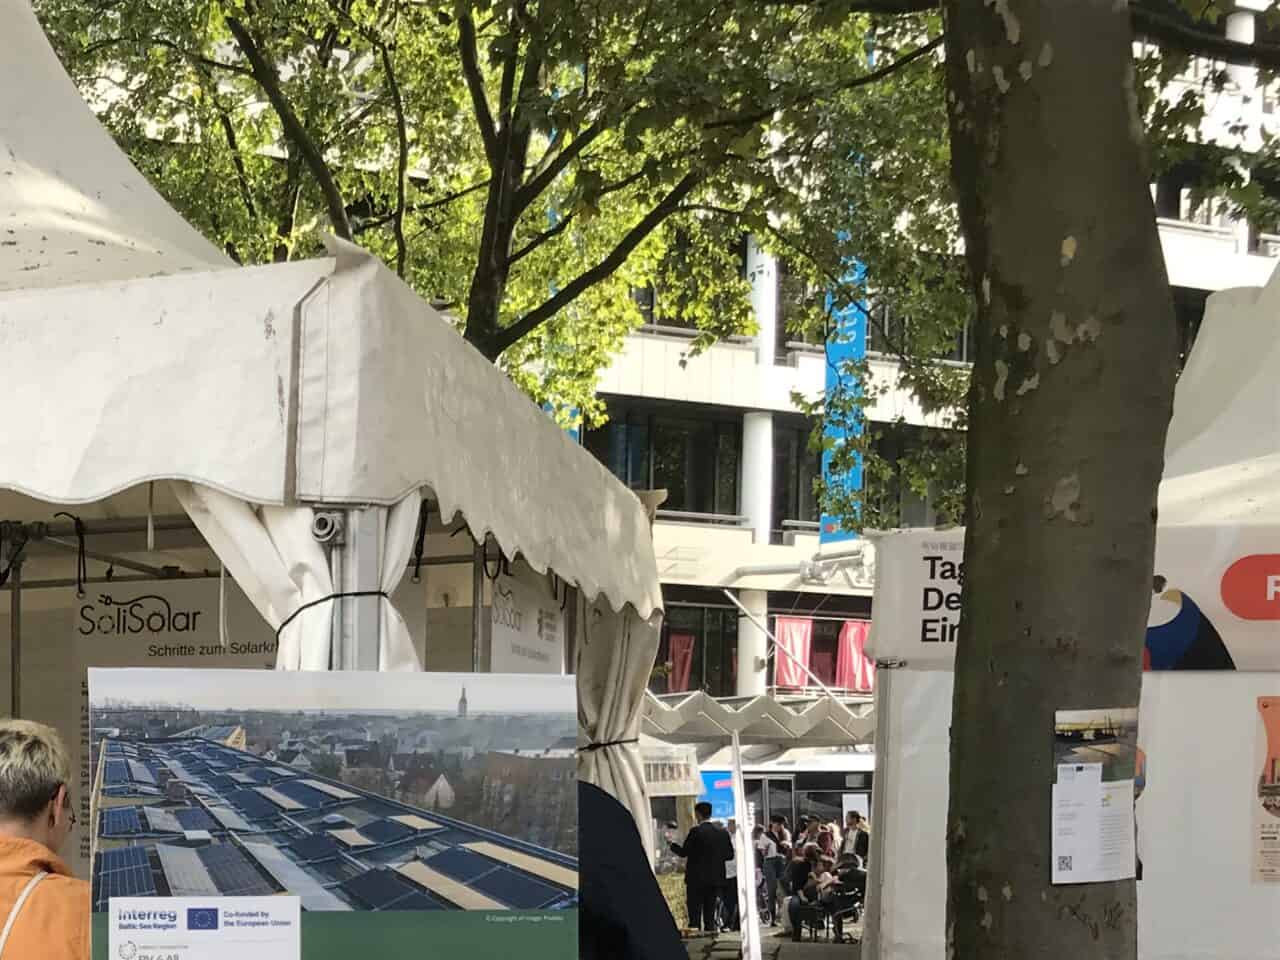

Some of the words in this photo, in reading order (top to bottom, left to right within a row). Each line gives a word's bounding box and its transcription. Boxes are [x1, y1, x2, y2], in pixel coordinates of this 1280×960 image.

[79, 603, 201, 635] SoliSolar
[148, 644, 195, 657] Schritte
[199, 645, 226, 656] zum
